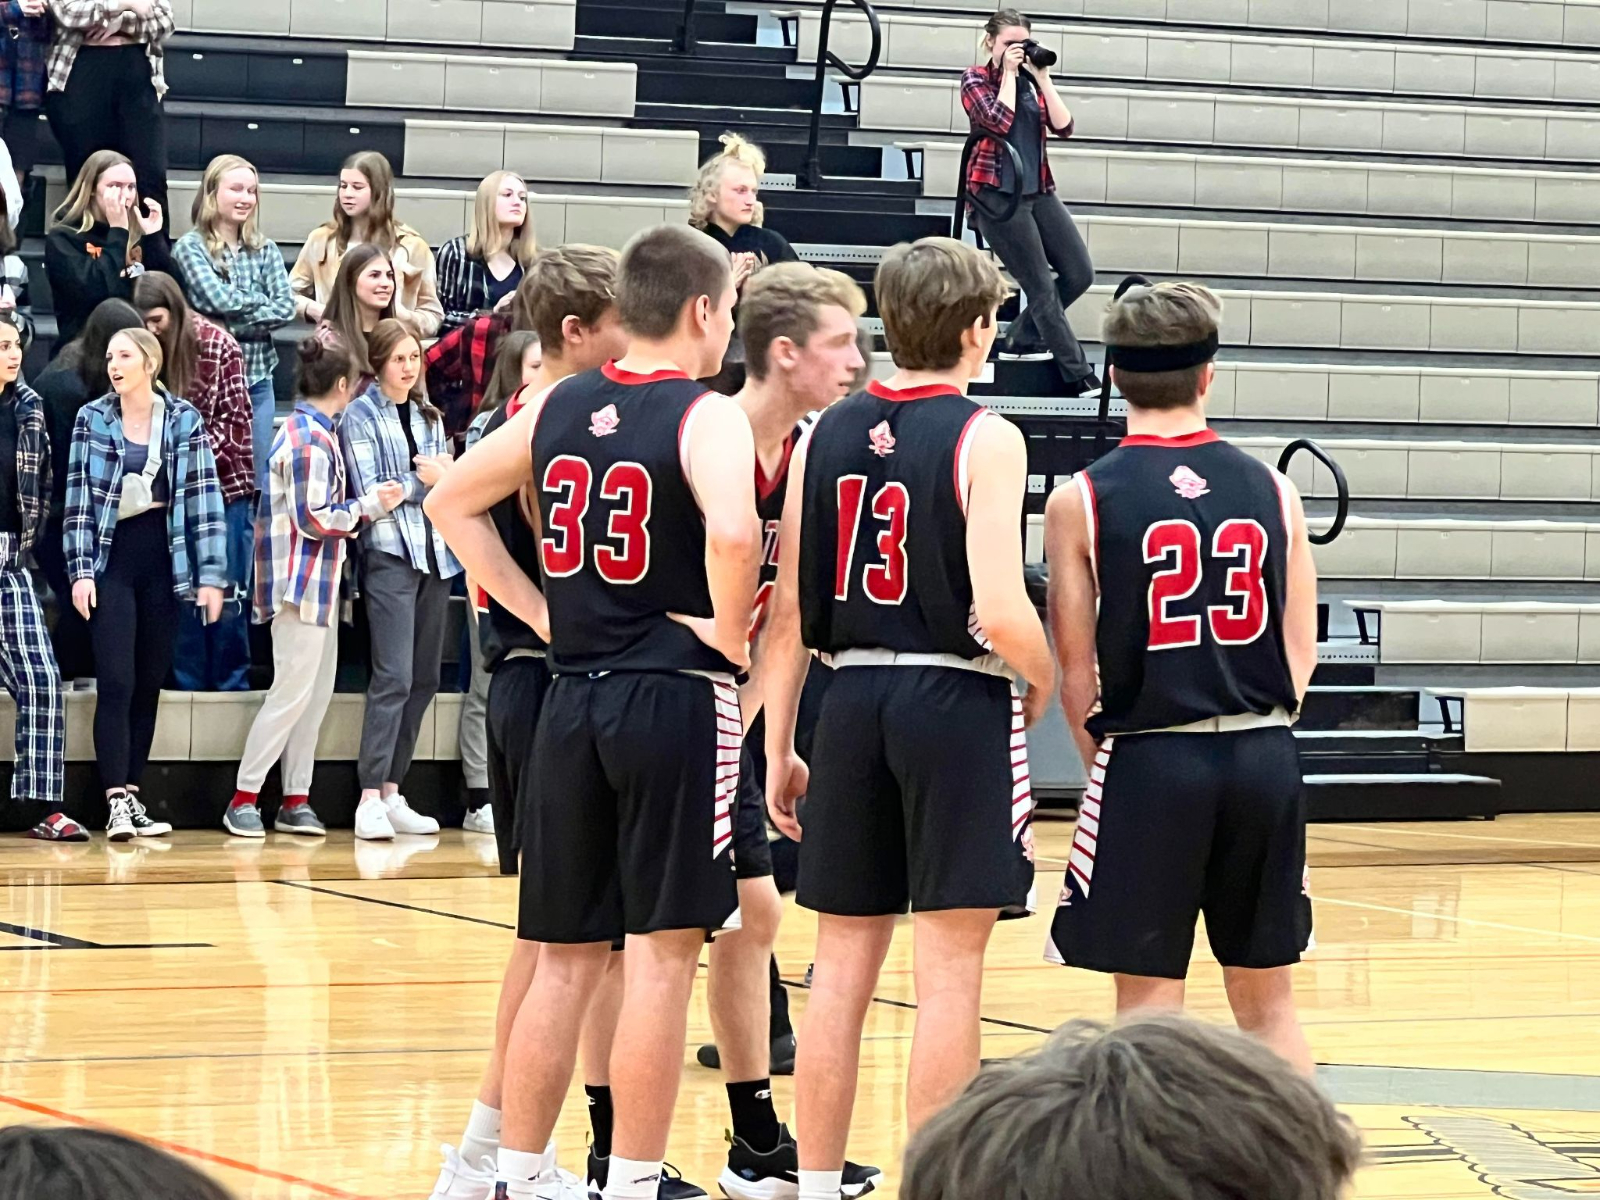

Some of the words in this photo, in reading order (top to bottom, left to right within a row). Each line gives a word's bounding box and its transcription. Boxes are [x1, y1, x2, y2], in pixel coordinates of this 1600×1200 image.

[541, 454, 653, 584] 33
[834, 474, 910, 605] 13
[1142, 518, 1269, 651] 23
